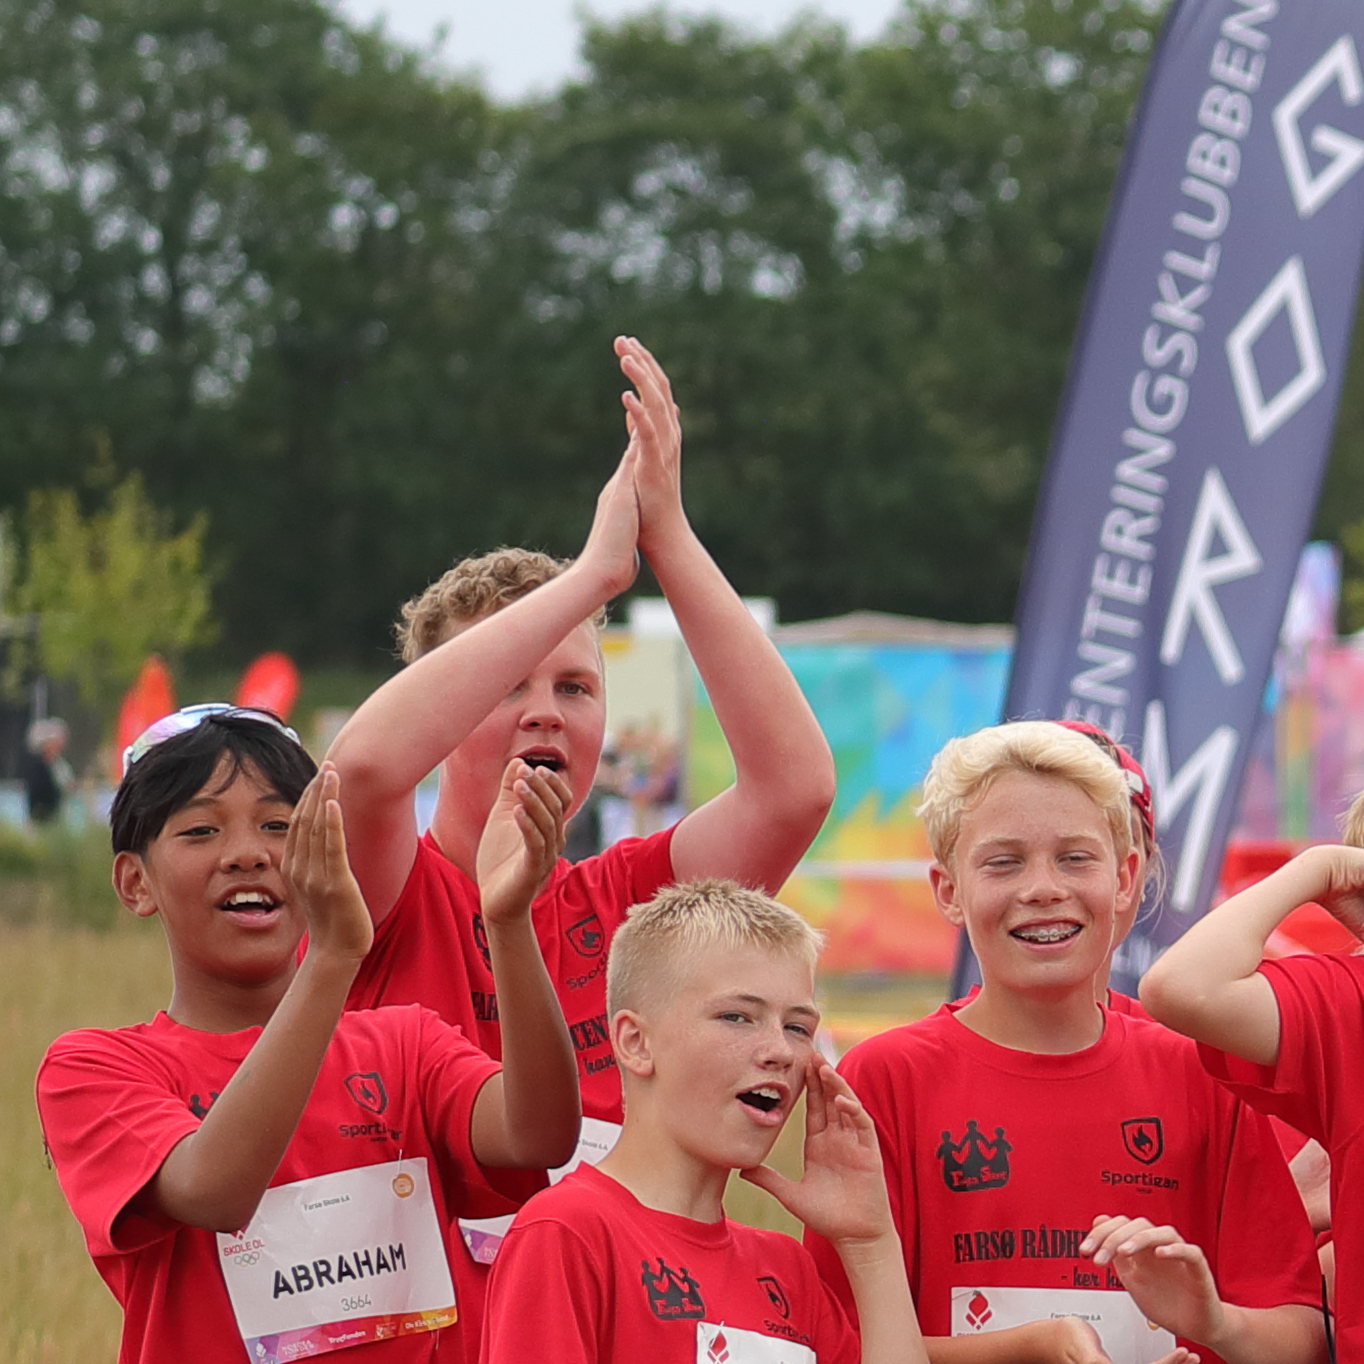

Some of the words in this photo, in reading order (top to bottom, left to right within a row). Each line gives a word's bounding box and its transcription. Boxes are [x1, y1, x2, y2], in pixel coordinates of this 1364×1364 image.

[1101, 1170, 1179, 1191] Sportigan
[223, 1242, 251, 1257] SKOLE
[253, 1238, 266, 1250] OL
[953, 1229, 1015, 1264] FARSØ
[273, 1242, 407, 1299] ABRAHAM
[341, 1294, 372, 1312] 3664
